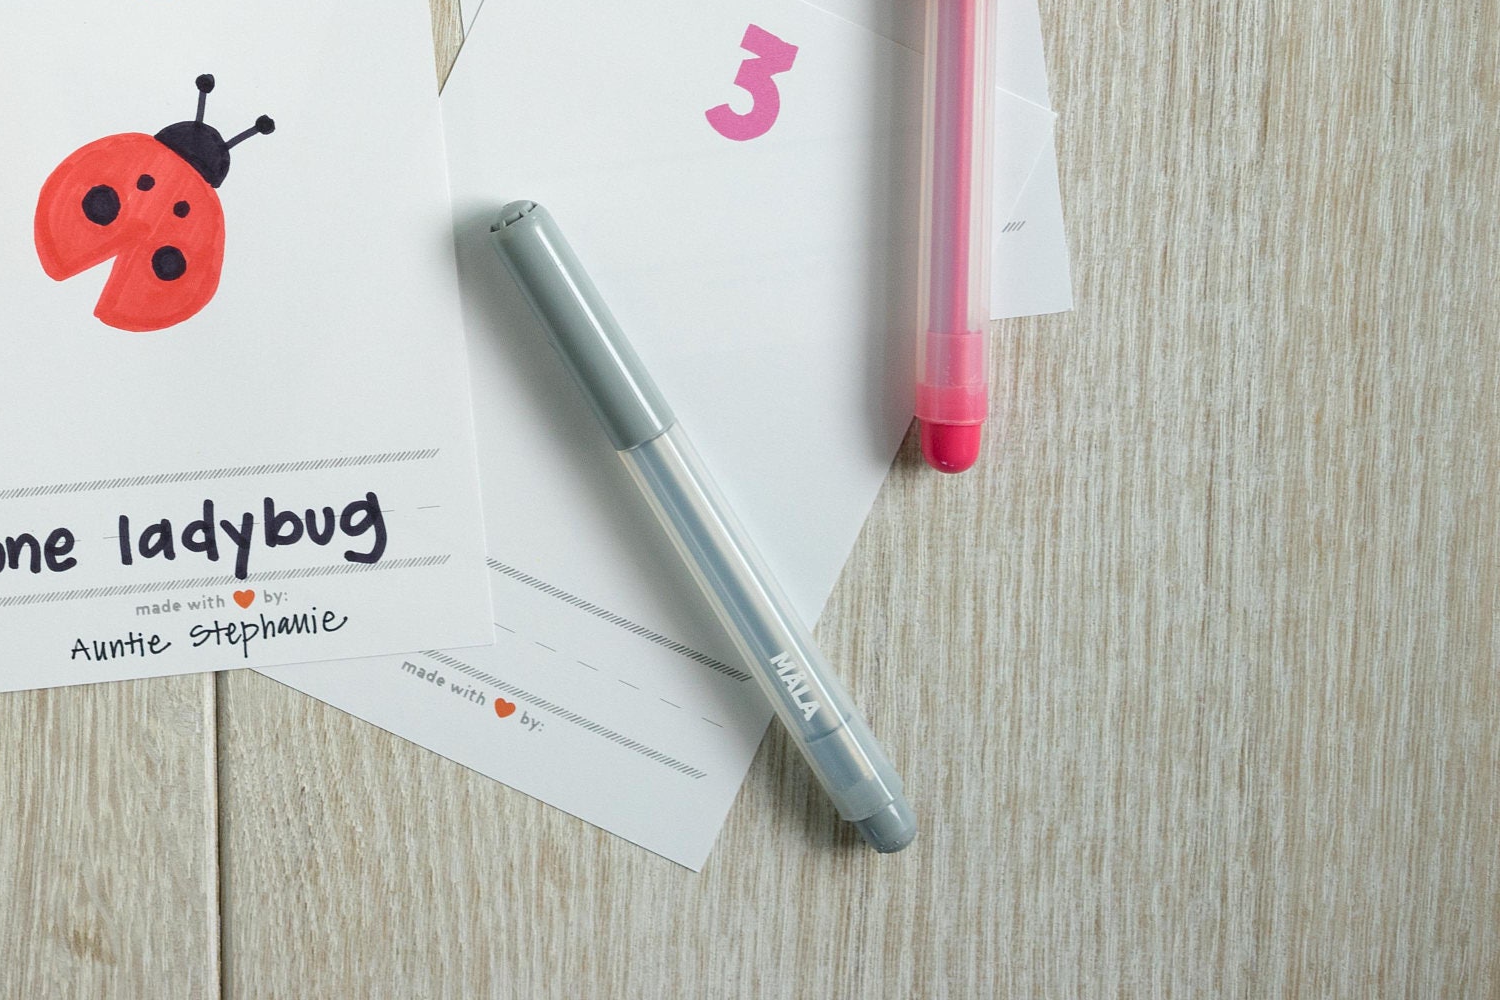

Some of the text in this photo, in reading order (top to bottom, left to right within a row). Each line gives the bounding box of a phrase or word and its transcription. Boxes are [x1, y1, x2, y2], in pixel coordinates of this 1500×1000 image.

[705, 23, 799, 141] 3
[118, 491, 388, 581] ladybug
[70, 606, 349, 661] Auntie Stephanie
[135, 589, 289, 616] made with by:
[401, 660, 546, 733] made with by:
